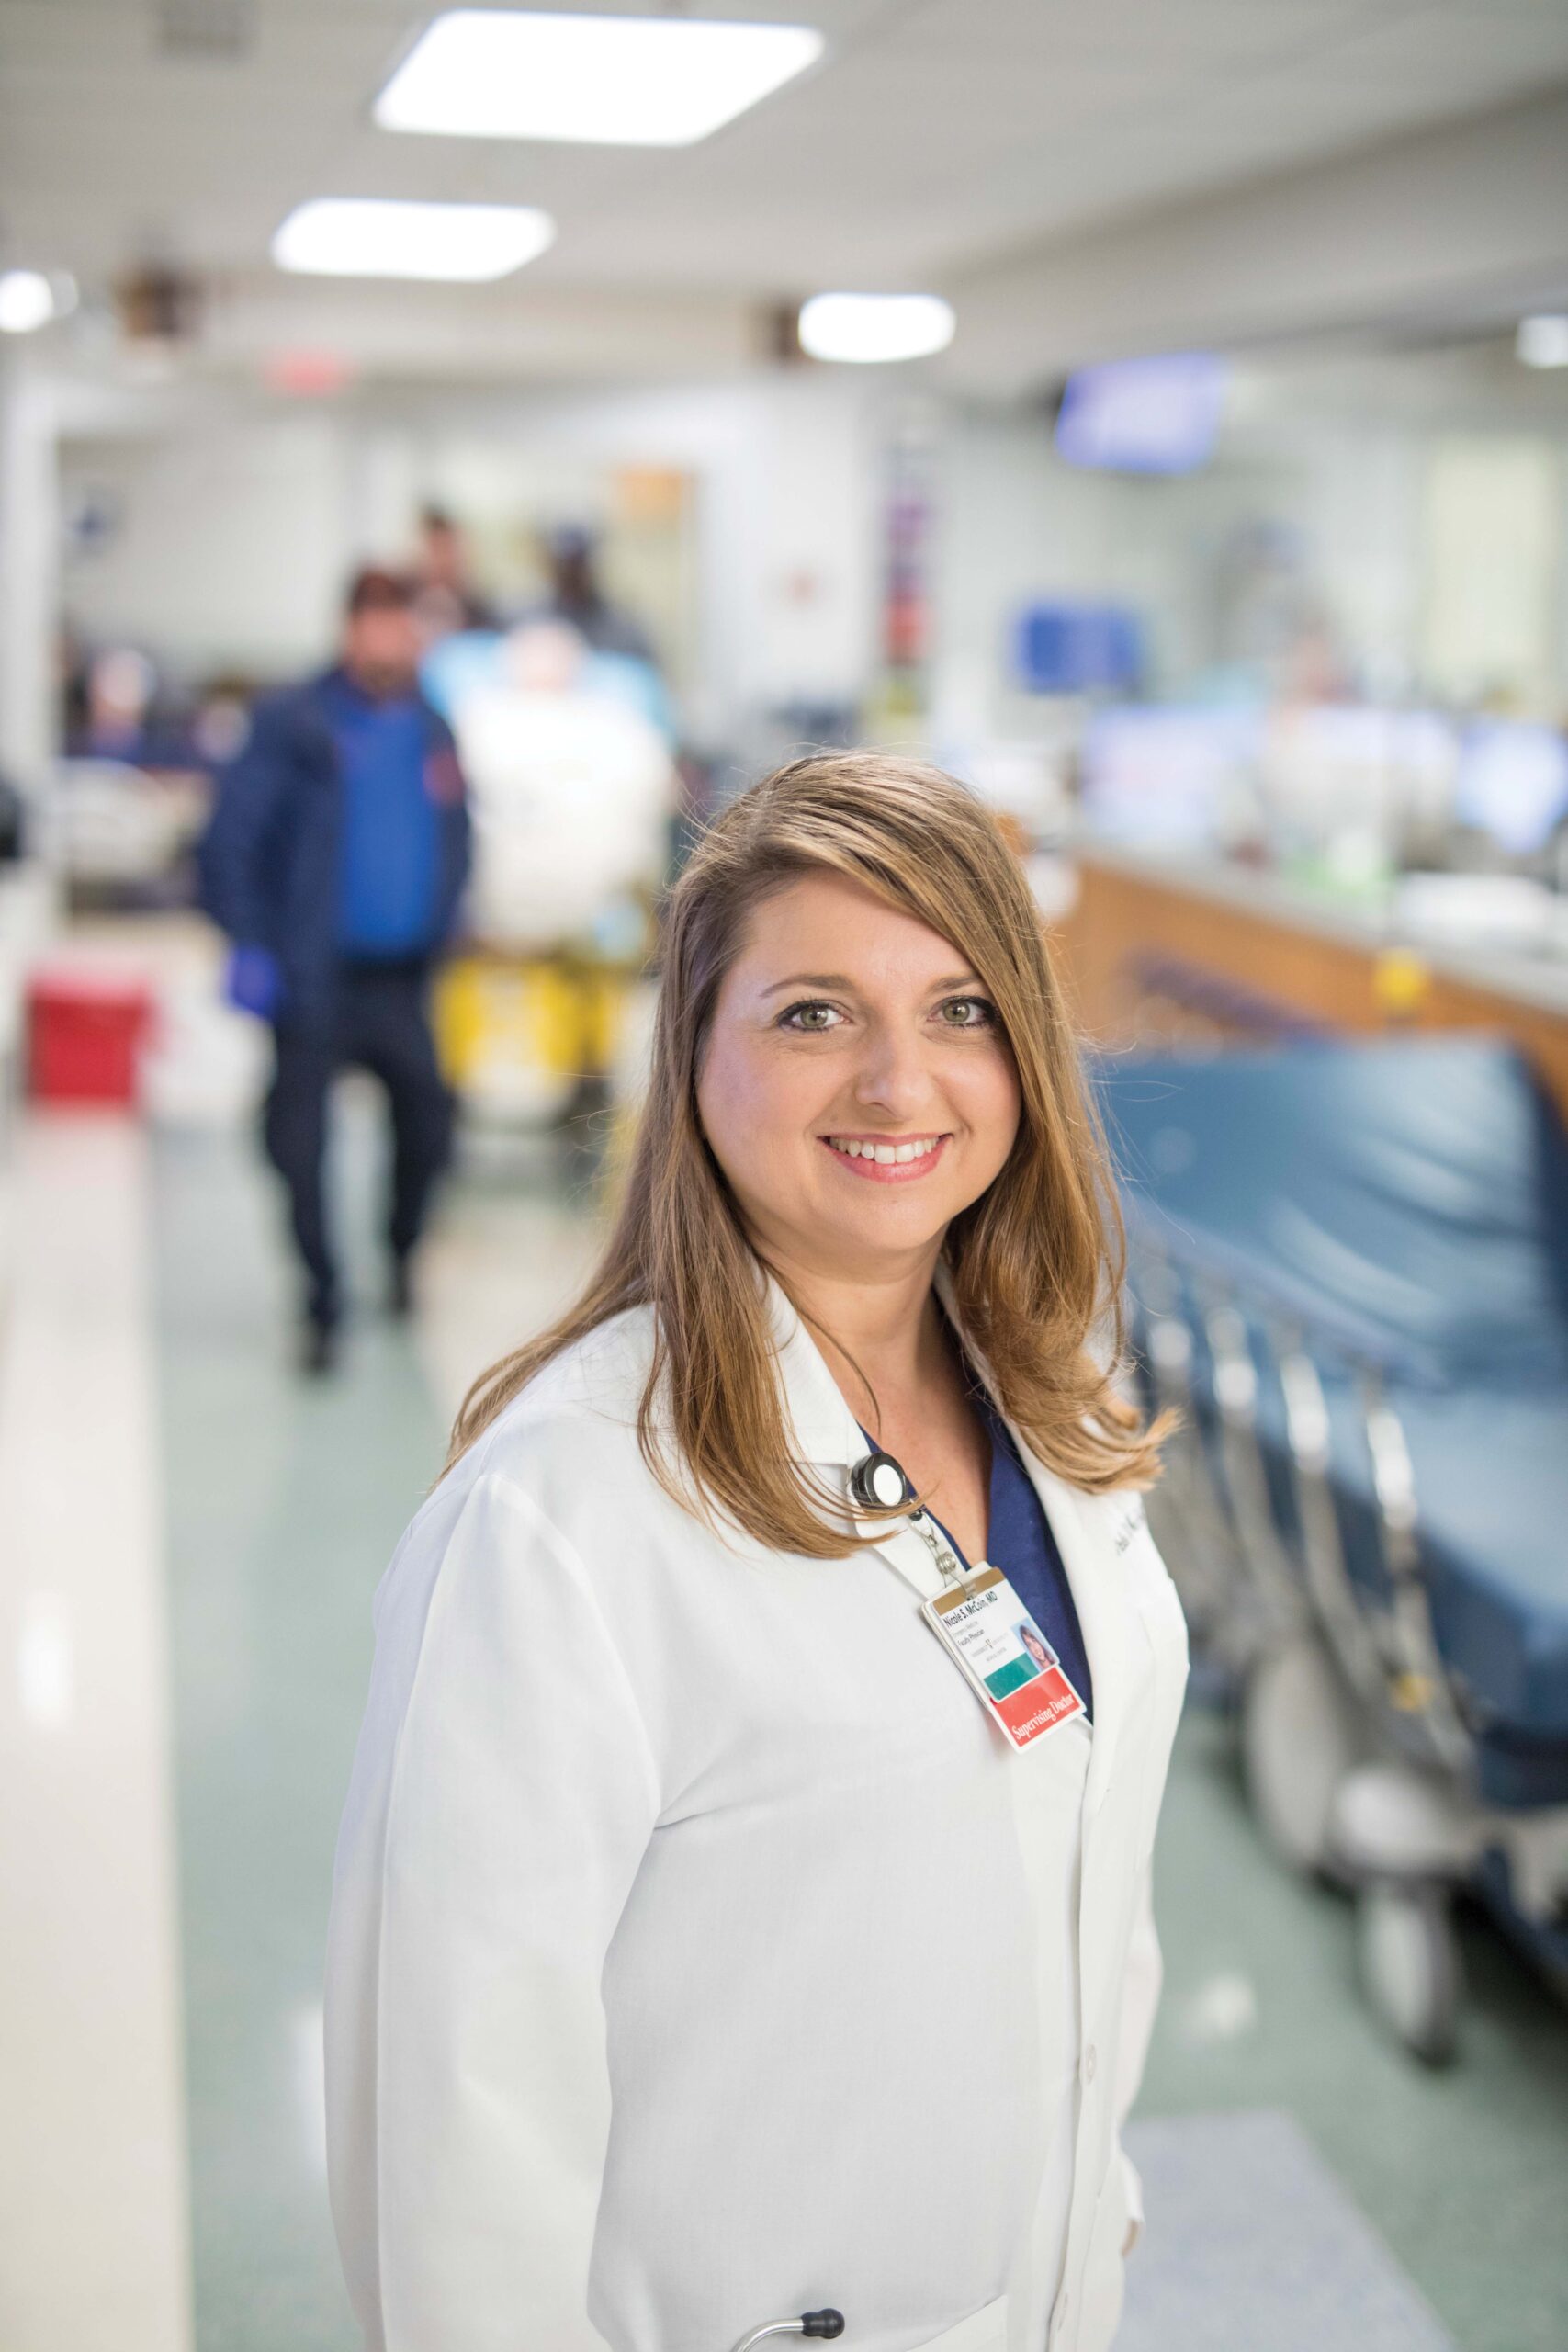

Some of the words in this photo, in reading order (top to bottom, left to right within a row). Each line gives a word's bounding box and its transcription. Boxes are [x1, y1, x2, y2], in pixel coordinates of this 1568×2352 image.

[942, 1611, 964, 1628] Nicole
[959, 1608, 969, 1619] S.
[985, 1590, 998, 1604] MD
[1011, 1708, 1056, 1740] Supervising
[1048, 1693, 1075, 1715] Doctor
